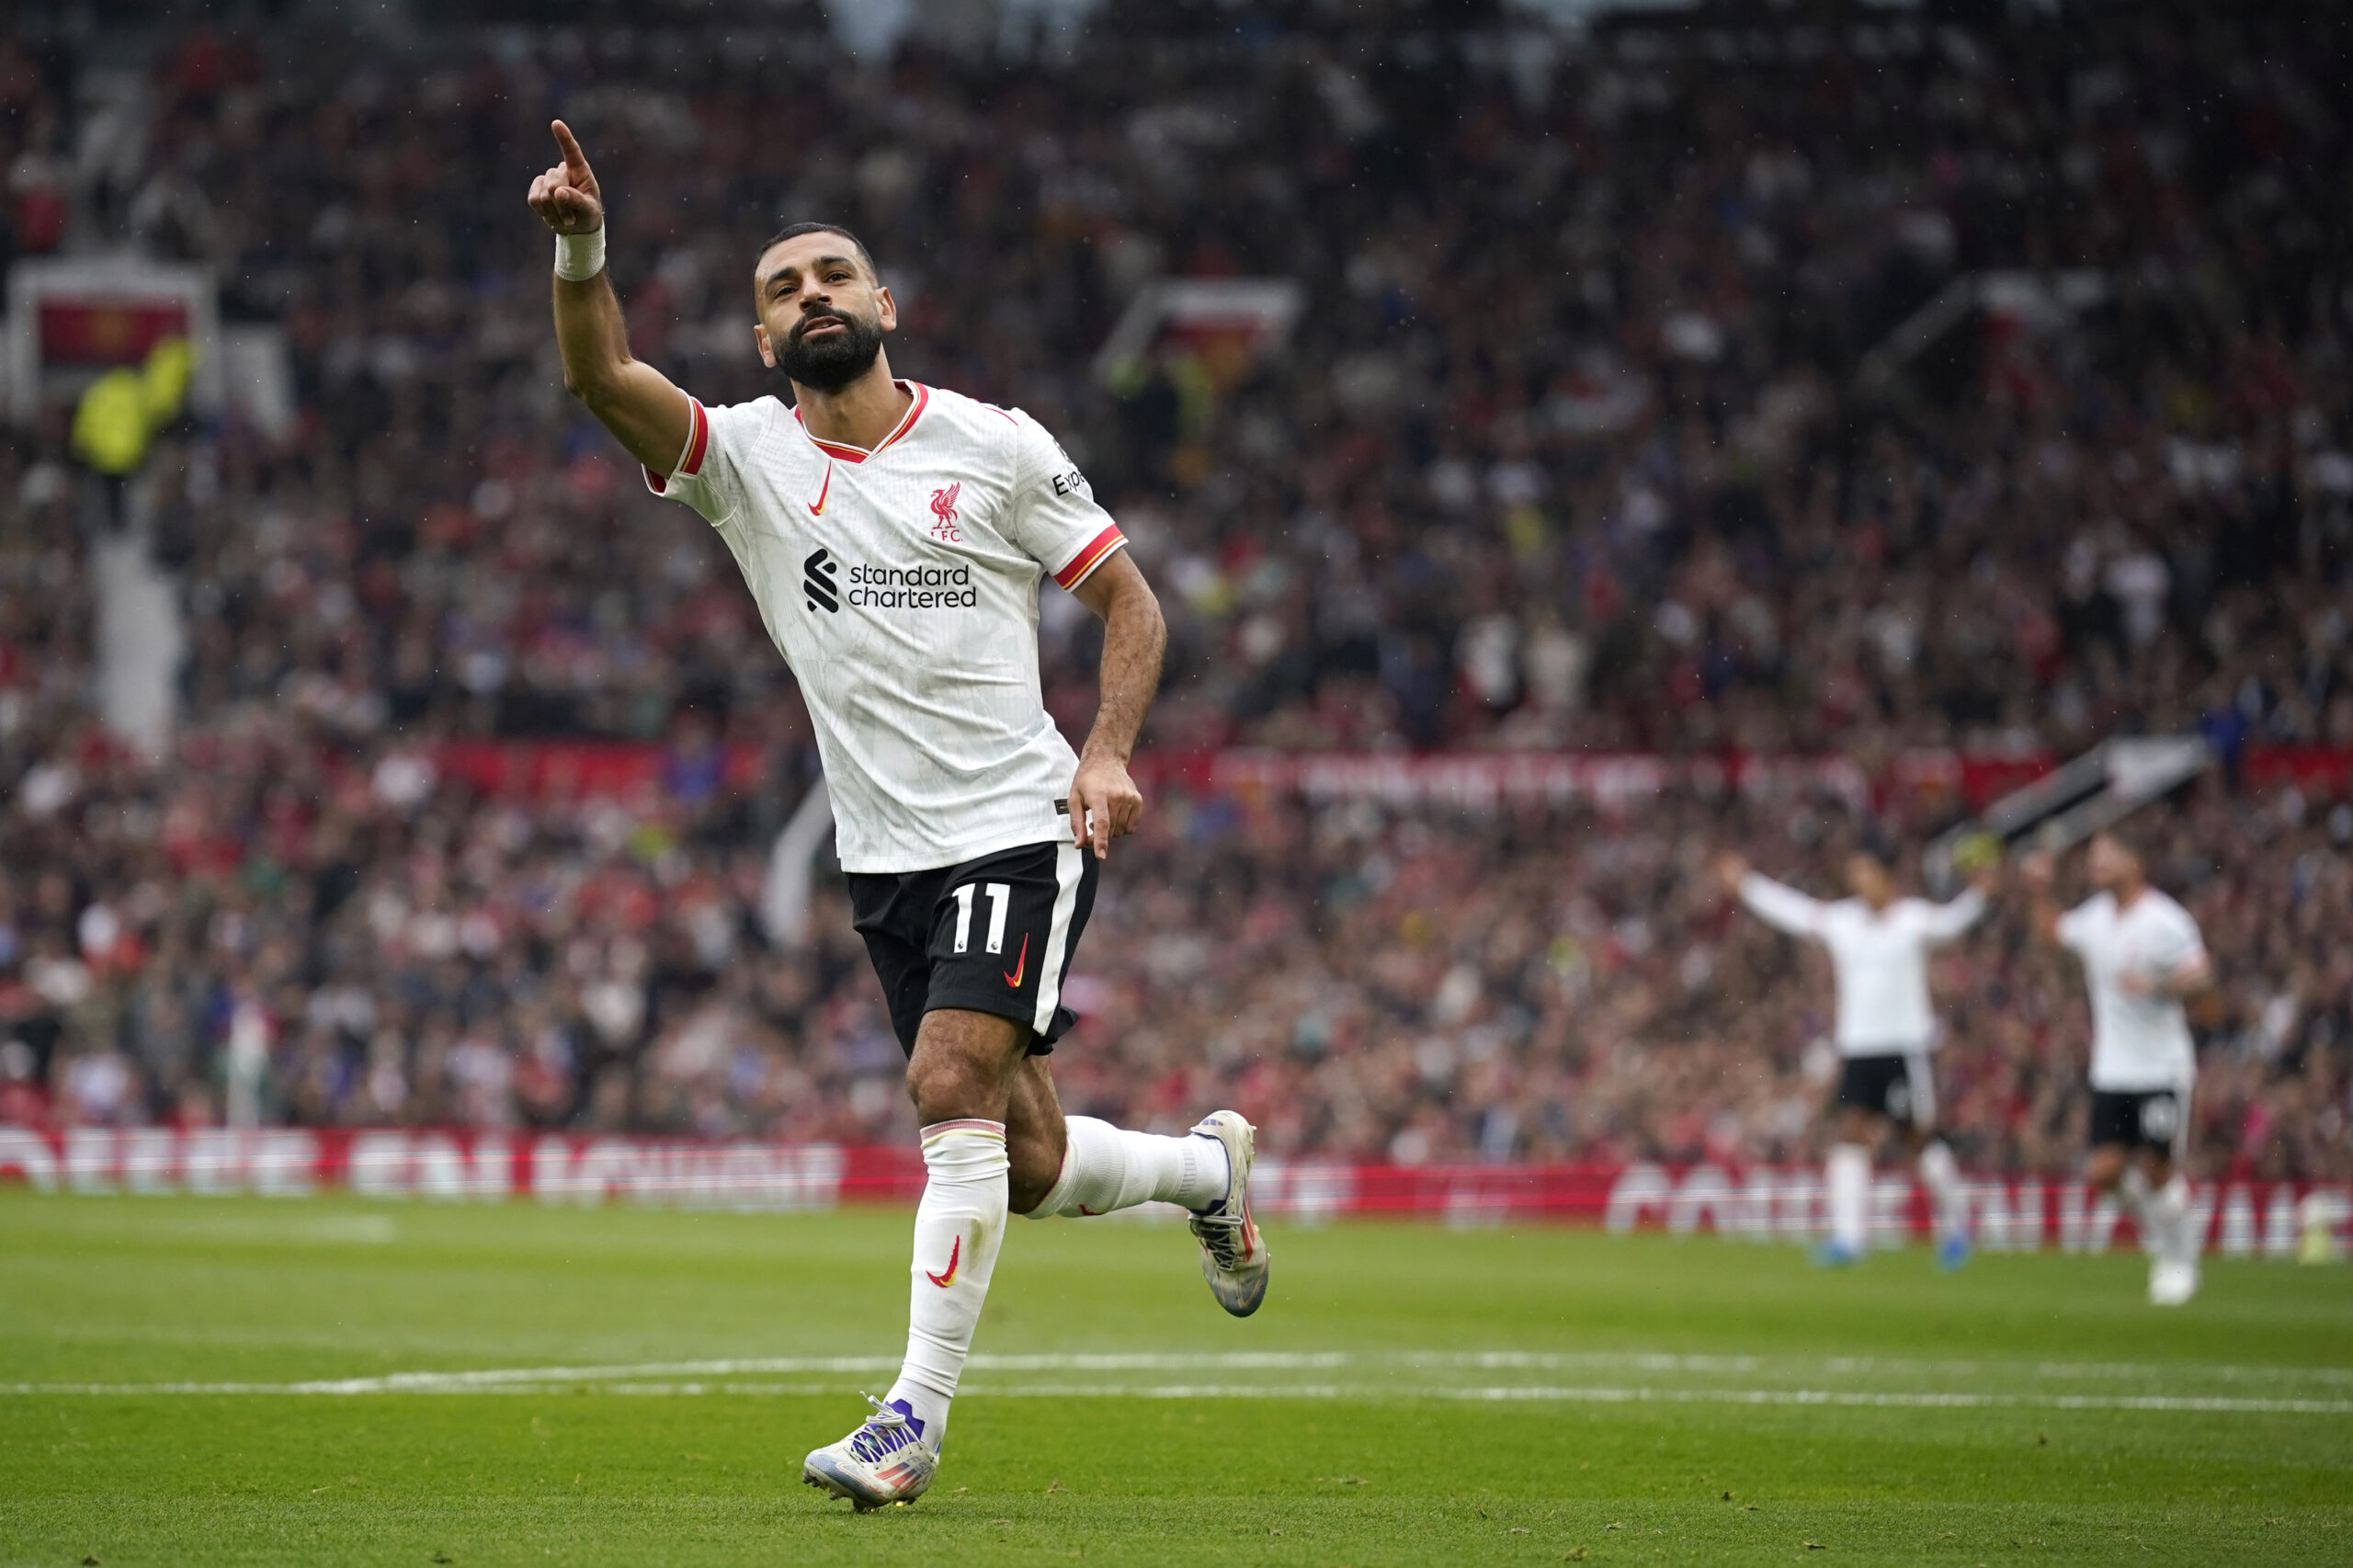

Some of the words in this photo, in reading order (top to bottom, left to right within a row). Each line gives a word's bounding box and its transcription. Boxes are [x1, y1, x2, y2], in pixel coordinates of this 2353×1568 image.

[849, 562, 969, 585] standard
[848, 585, 976, 608] chartered
[952, 882, 1010, 954] 11
